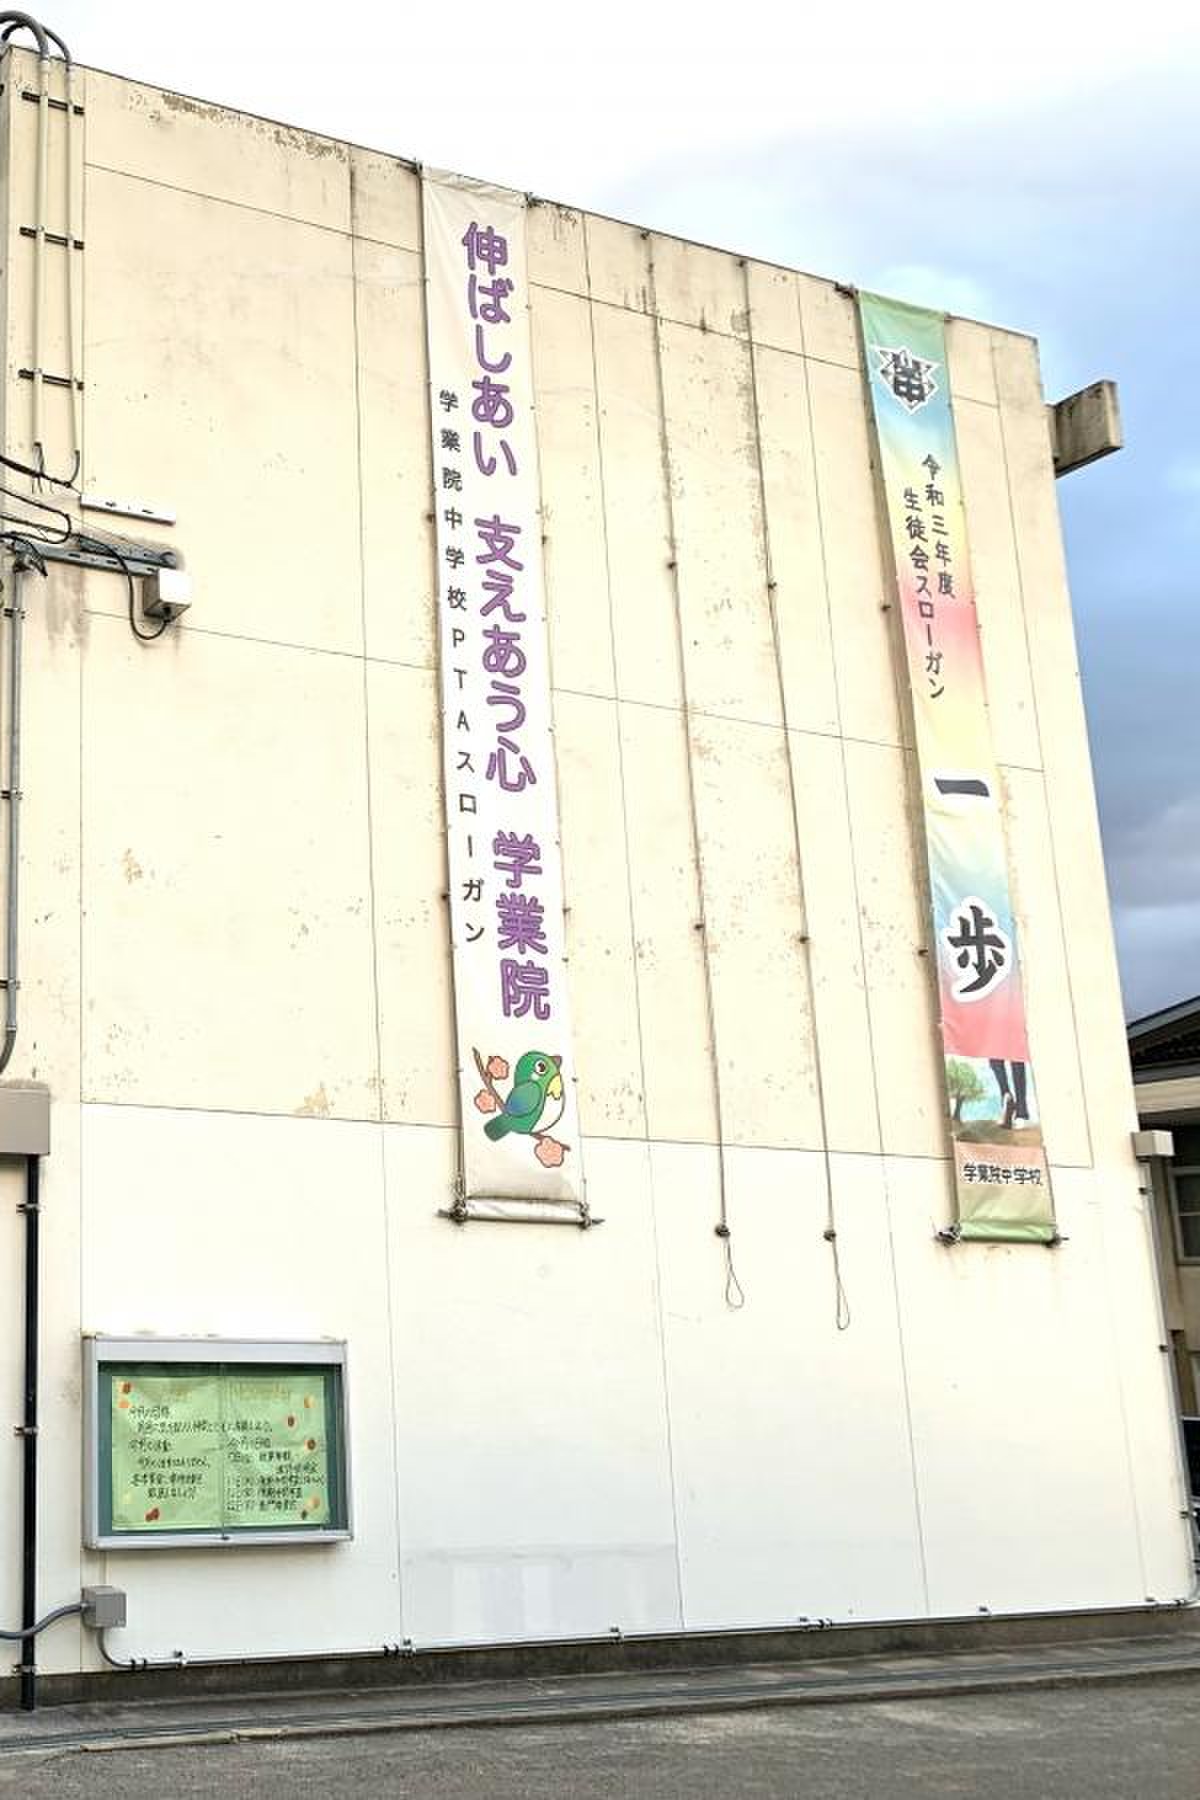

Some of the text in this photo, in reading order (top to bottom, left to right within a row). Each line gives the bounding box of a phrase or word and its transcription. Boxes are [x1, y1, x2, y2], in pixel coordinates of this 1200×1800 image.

[462, 221, 551, 1021] 伸ばしあい 支えあう心 学業院
[903, 486, 945, 700] 生徒会スローガン
[921, 453, 956, 600] 令和三年度
